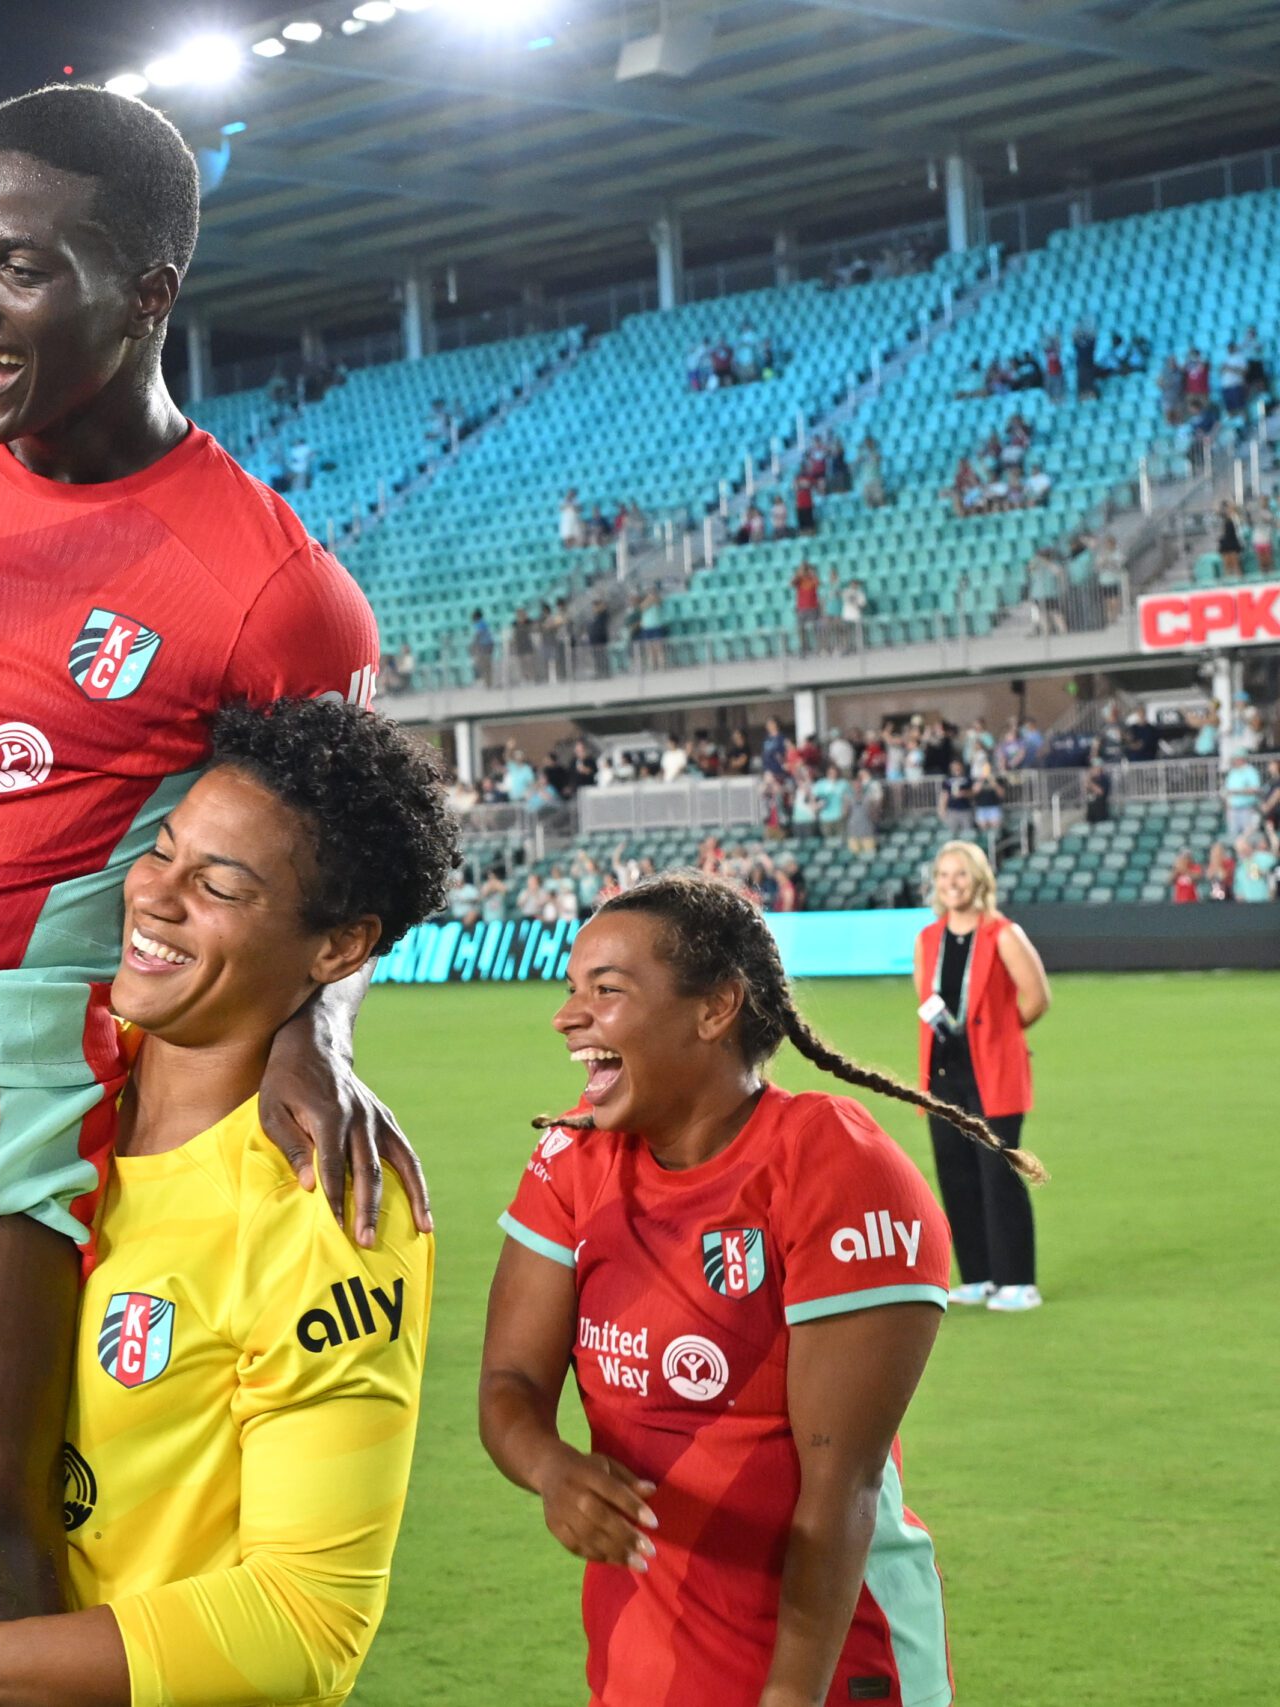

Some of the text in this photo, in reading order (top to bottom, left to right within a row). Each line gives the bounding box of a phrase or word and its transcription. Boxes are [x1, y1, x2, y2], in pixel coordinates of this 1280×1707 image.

[1141, 586, 1280, 647] CPK
[831, 1210, 921, 1266] ally
[296, 1275, 405, 1353] ally
[580, 1316, 649, 1360] United
[597, 1354, 650, 1397] Way
